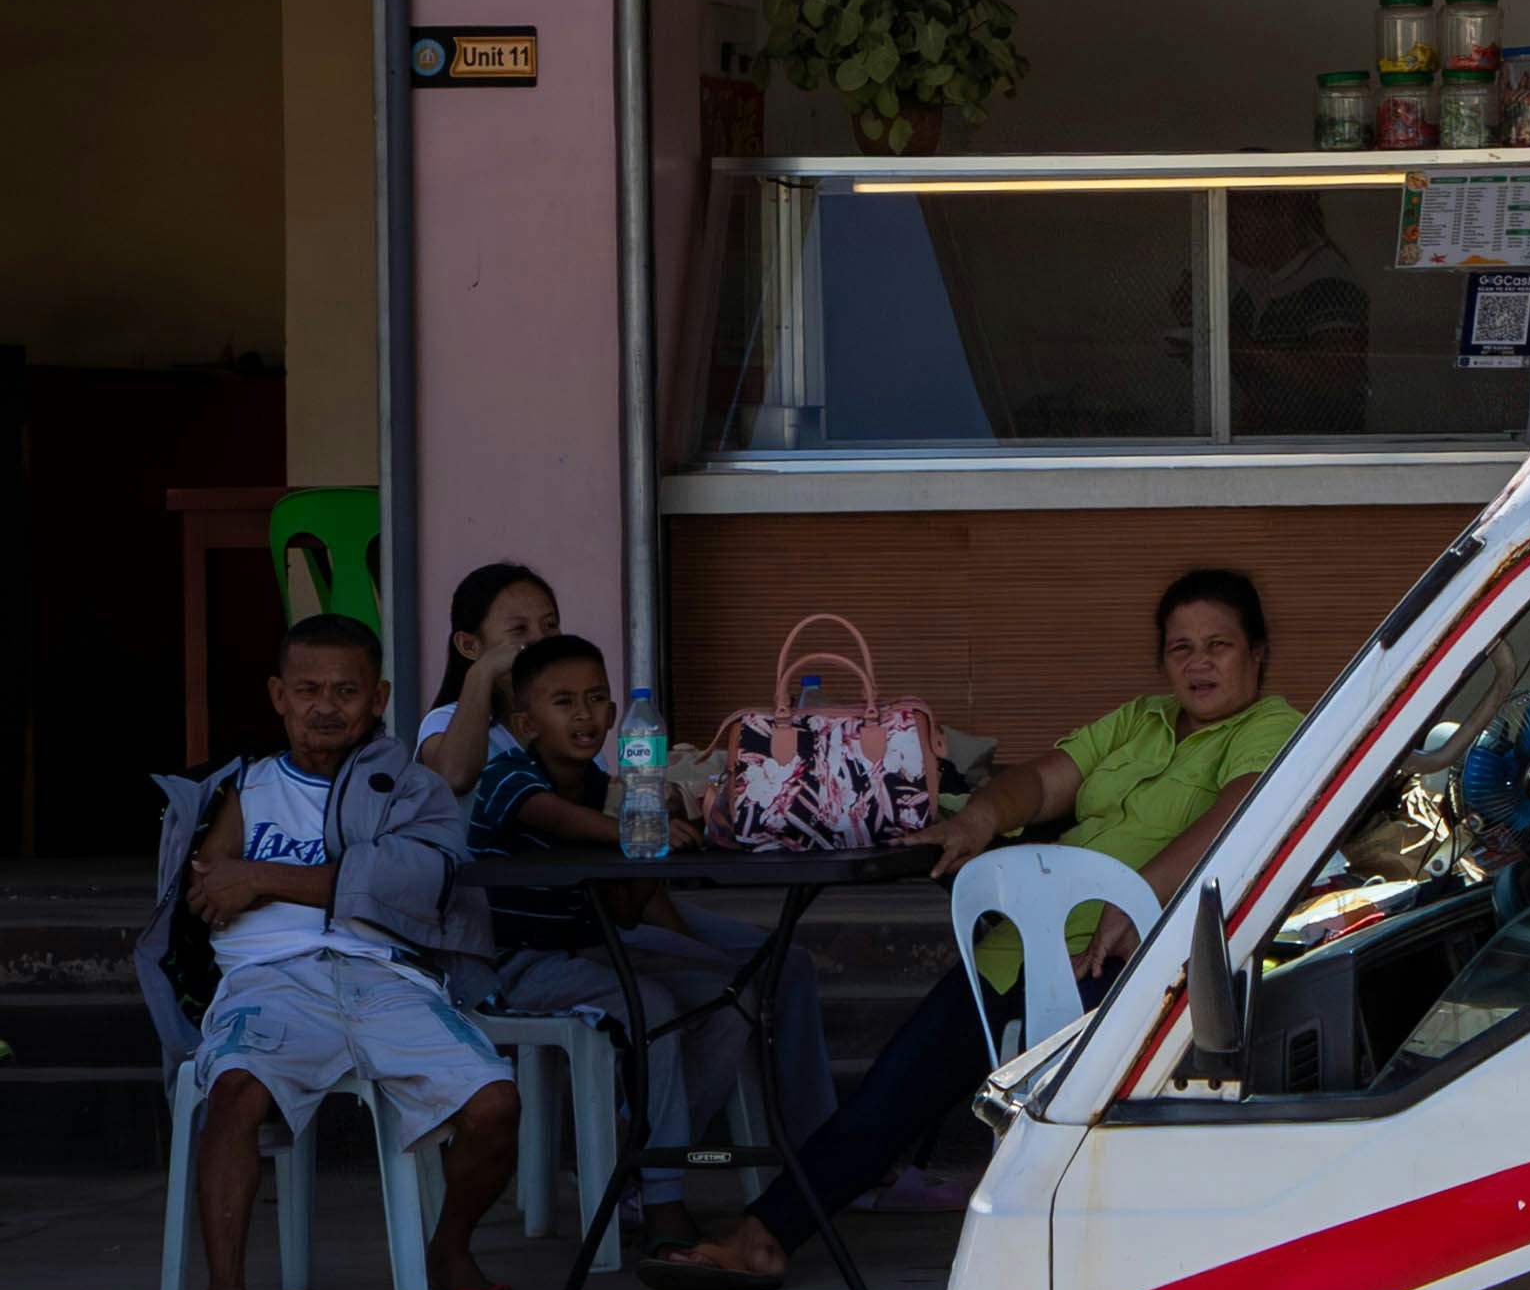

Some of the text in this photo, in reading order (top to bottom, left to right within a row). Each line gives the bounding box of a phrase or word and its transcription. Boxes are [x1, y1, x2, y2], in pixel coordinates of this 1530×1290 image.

[463, 45, 529, 67] Unit 11
[626, 747, 651, 759] pure
